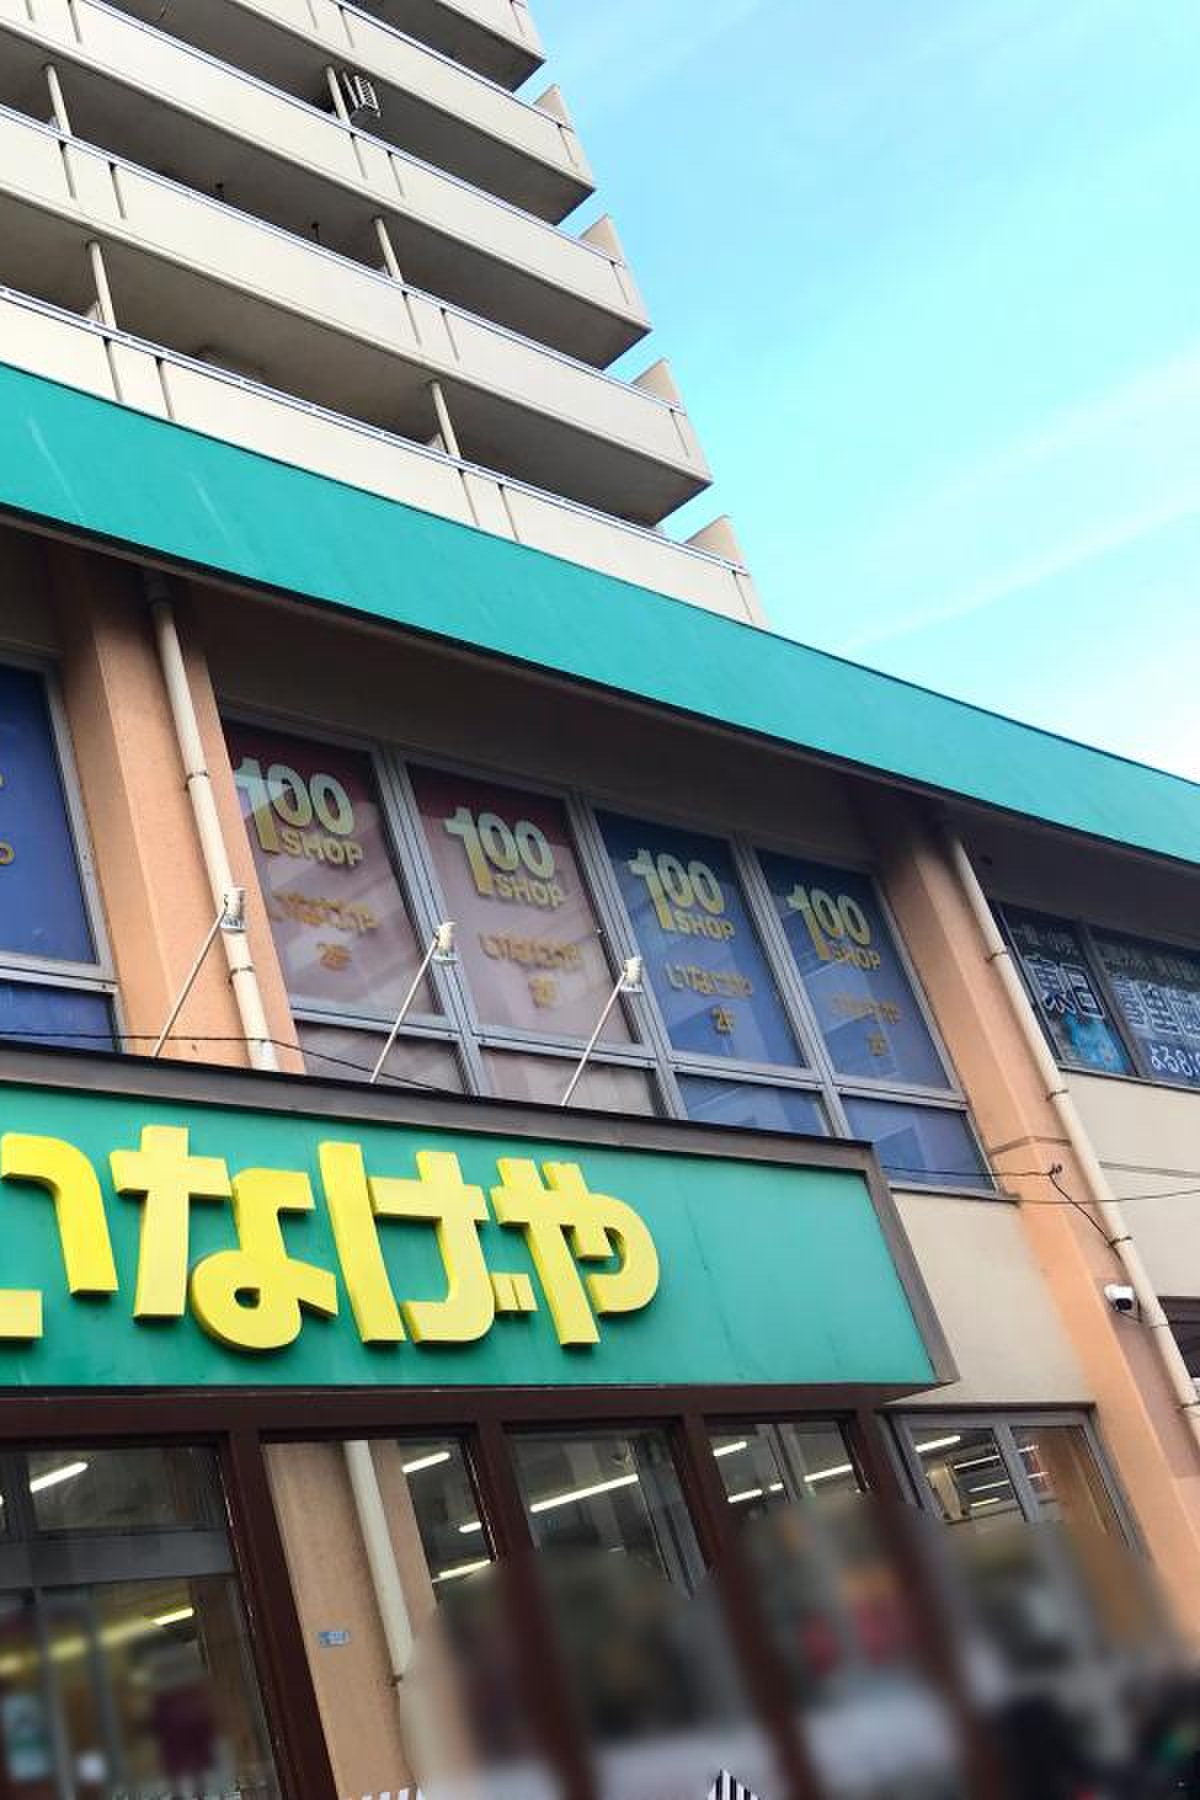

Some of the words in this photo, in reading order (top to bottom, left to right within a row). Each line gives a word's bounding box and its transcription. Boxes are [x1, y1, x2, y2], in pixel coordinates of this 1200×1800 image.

[234, 756, 355, 855] 100
[281, 831, 366, 868] SHOP
[445, 806, 555, 897] 100
[494, 872, 566, 911] SHOP
[628, 848, 725, 931] 100
[672, 910, 736, 943] SHOP
[786, 884, 871, 961] 100
[831, 941, 883, 972] SHOP
